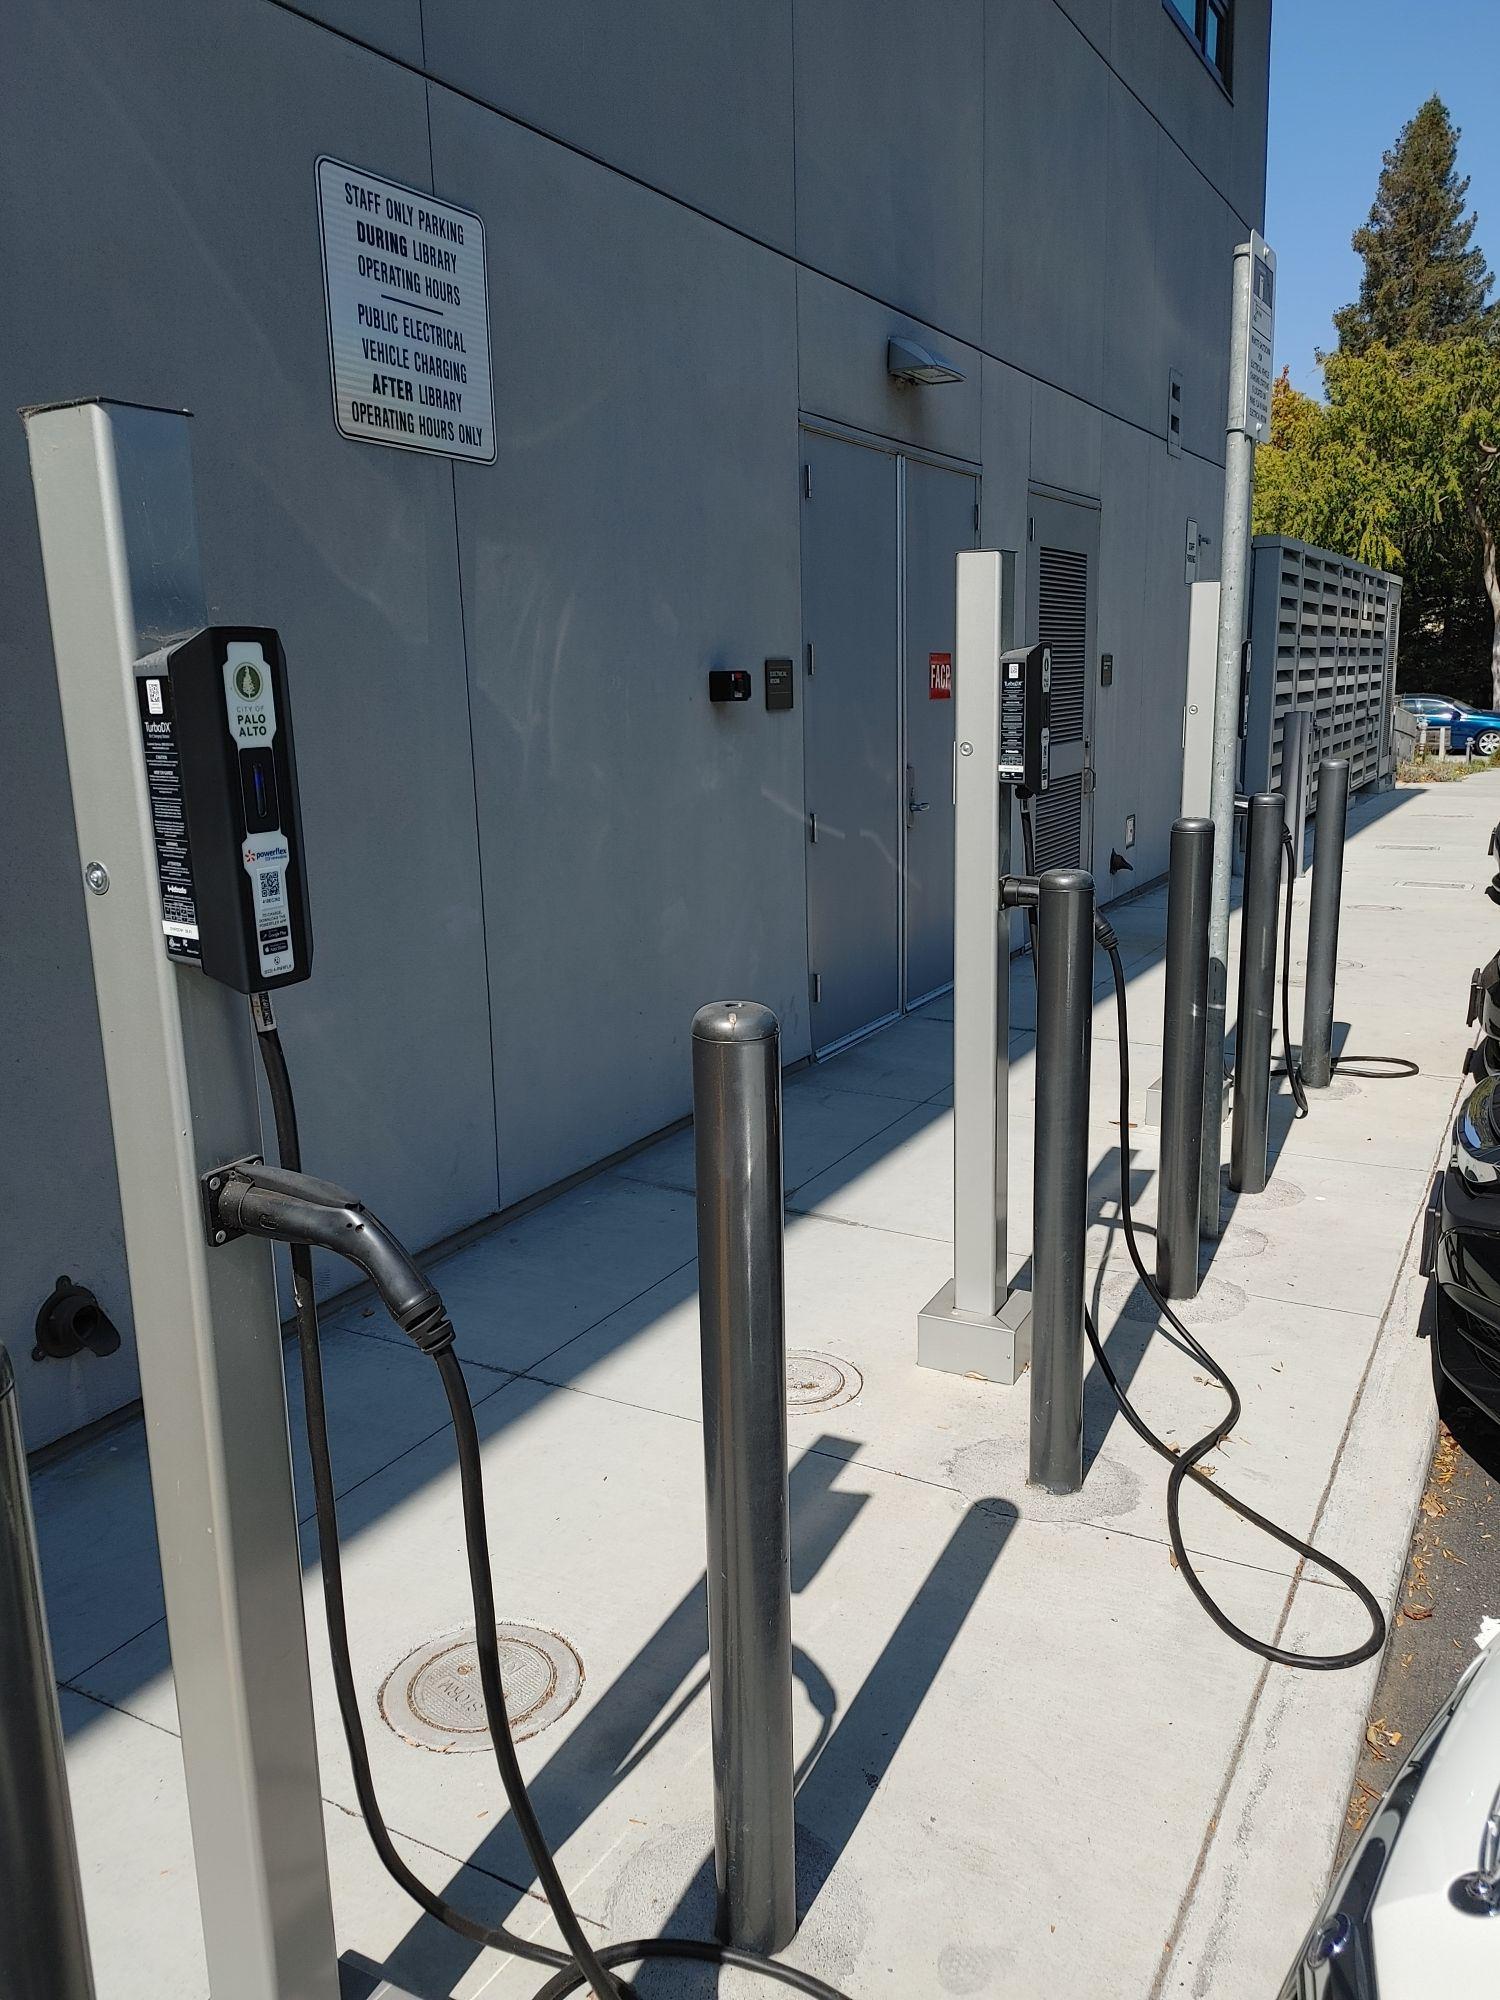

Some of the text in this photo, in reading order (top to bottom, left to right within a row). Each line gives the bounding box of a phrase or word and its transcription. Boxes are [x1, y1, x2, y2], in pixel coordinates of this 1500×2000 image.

[344, 182, 465, 245] STAFF ONLY PARKING
[356, 220, 457, 274] DURING LIBRARY
[357, 254, 461, 306] OPERATING HOURS
[357, 303, 467, 353] PUBLIC ELECTRICAL
[361, 337, 467, 384] VEHICLE CHARGING
[372, 373, 462, 413] AFTER LIBRARY
[351, 400, 483, 448] OPERATING HOURS ONLY
[930, 664, 951, 689] FACP
[236, 705, 253, 713] CITY
[237, 714, 266, 725] PALO
[239, 726, 267, 737] ALTO
[256, 847, 287, 860] powerflex
